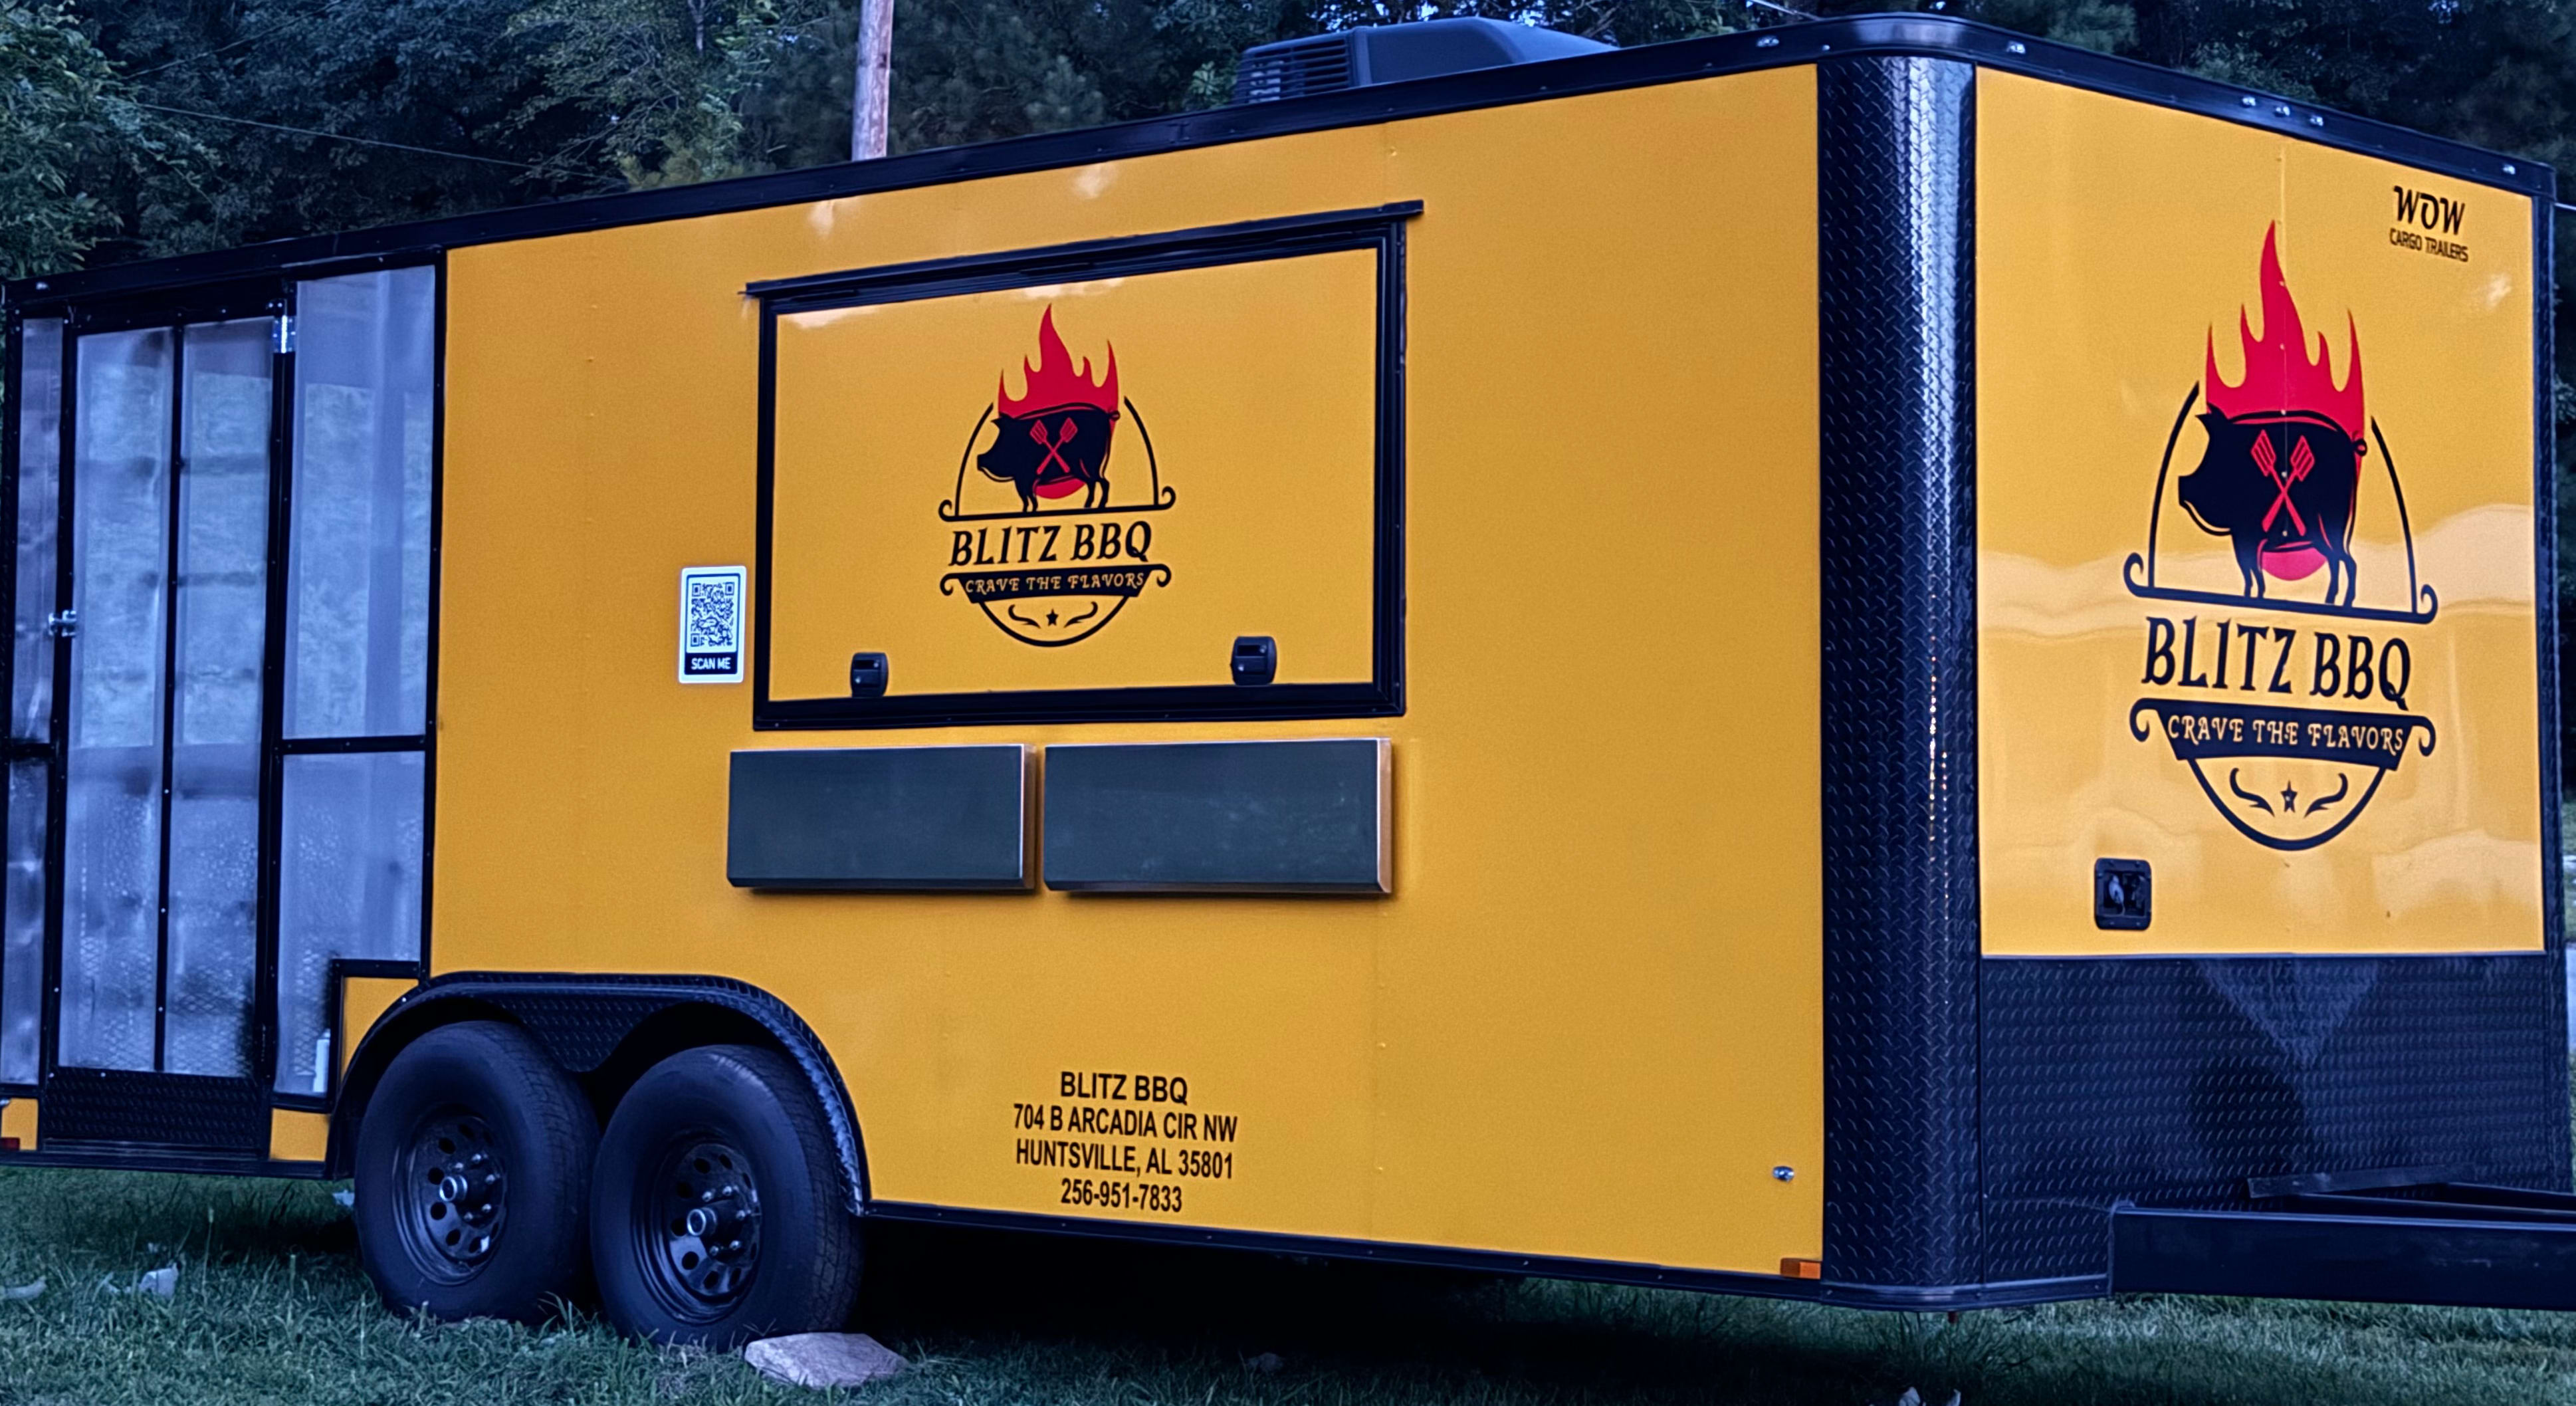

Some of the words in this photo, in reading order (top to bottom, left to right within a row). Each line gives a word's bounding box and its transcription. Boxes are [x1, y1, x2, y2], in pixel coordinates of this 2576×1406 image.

[2393, 185, 2465, 235] WOW
[2389, 227, 2422, 251] CARGO
[2424, 237, 2468, 262] TRAILERS
[948, 525, 1061, 566] BLITZ
[1070, 521, 1152, 562] BBQ
[965, 578, 1020, 595] CRAVE
[1026, 576, 1061, 590] THE
[1067, 572, 1144, 589] FLAVORS
[691, 657, 715, 669] SCAN
[718, 657, 731, 669] ME
[2141, 616, 2296, 694] BLITZ
[2309, 632, 2411, 711] BBQ
[2167, 715, 2244, 745] CRAVE
[2253, 720, 2299, 745] THE
[2308, 723, 2403, 756] FLAVORS
[1060, 1071, 1127, 1100] BLITZ
[1134, 1076, 1188, 1106] BBQ
[1014, 1104, 1043, 1129] 704
[1050, 1106, 1062, 1131] B
[1068, 1106, 1157, 1137] ARCADIA
[1163, 1112, 1197, 1140] CIR
[1204, 1114, 1237, 1142] NW
[1016, 1139, 1140, 1177] HUNTSVILLE,
[1146, 1147, 1172, 1174] AL
[1178, 1149, 1232, 1179] 35801
[1061, 1178, 1182, 1212] 256-951-7833
